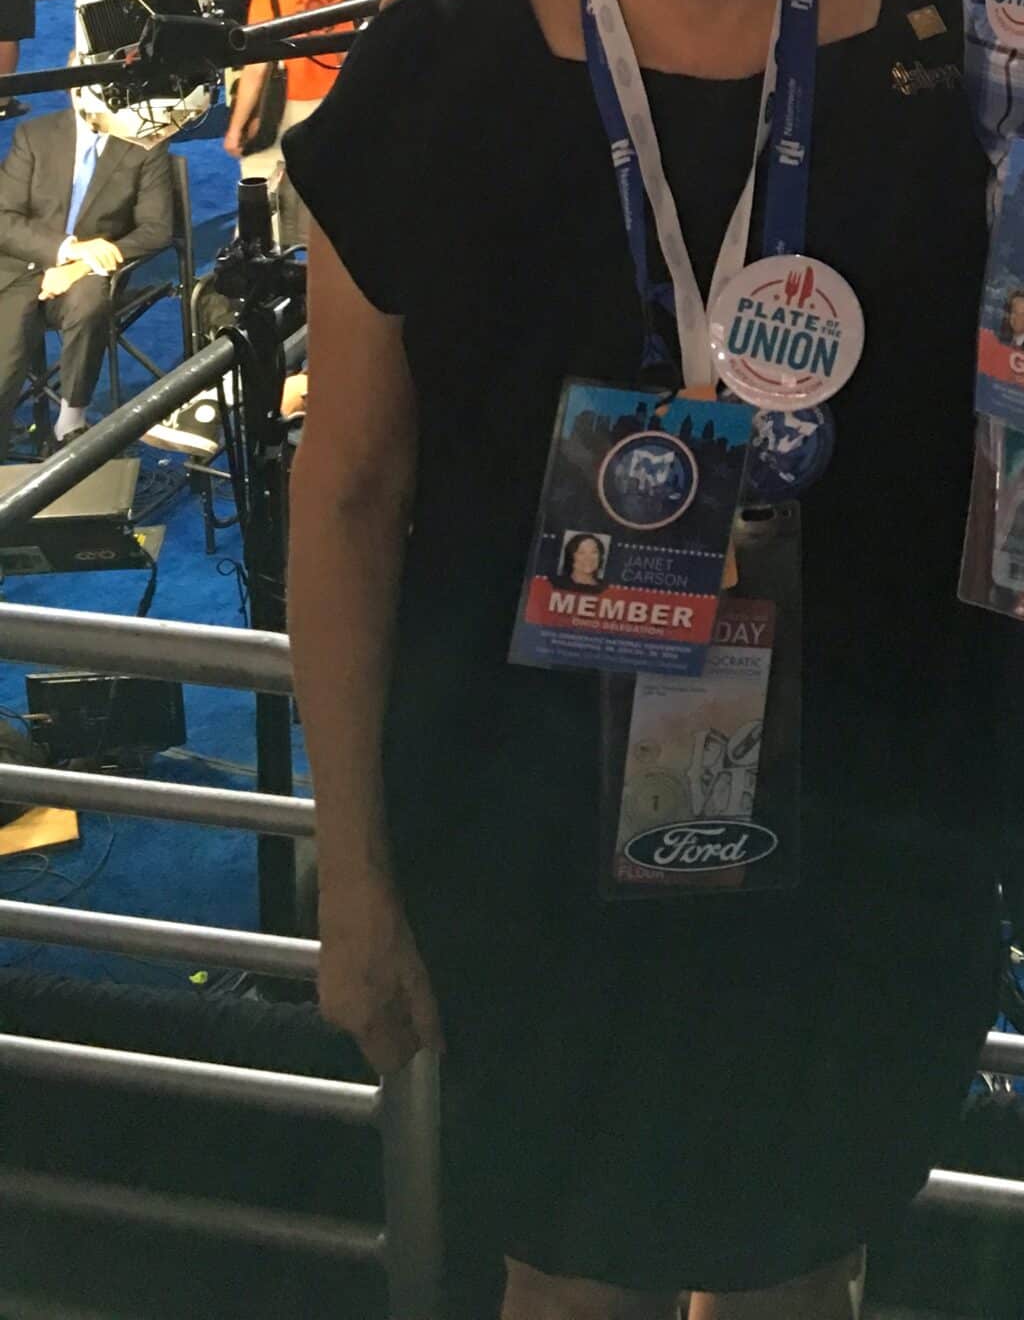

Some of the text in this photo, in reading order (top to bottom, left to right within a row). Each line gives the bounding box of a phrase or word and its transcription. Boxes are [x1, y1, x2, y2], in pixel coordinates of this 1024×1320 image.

[737, 297, 820, 331] PLATE
[727, 316, 839, 378] UNION
[624, 555, 675, 571] JANET
[620, 569, 689, 588] CARSON
[548, 590, 694, 629] MEMBER
[712, 621, 765, 645] DAY
[710, 651, 761, 668] OCRATIC
[653, 827, 748, 865] Ford
